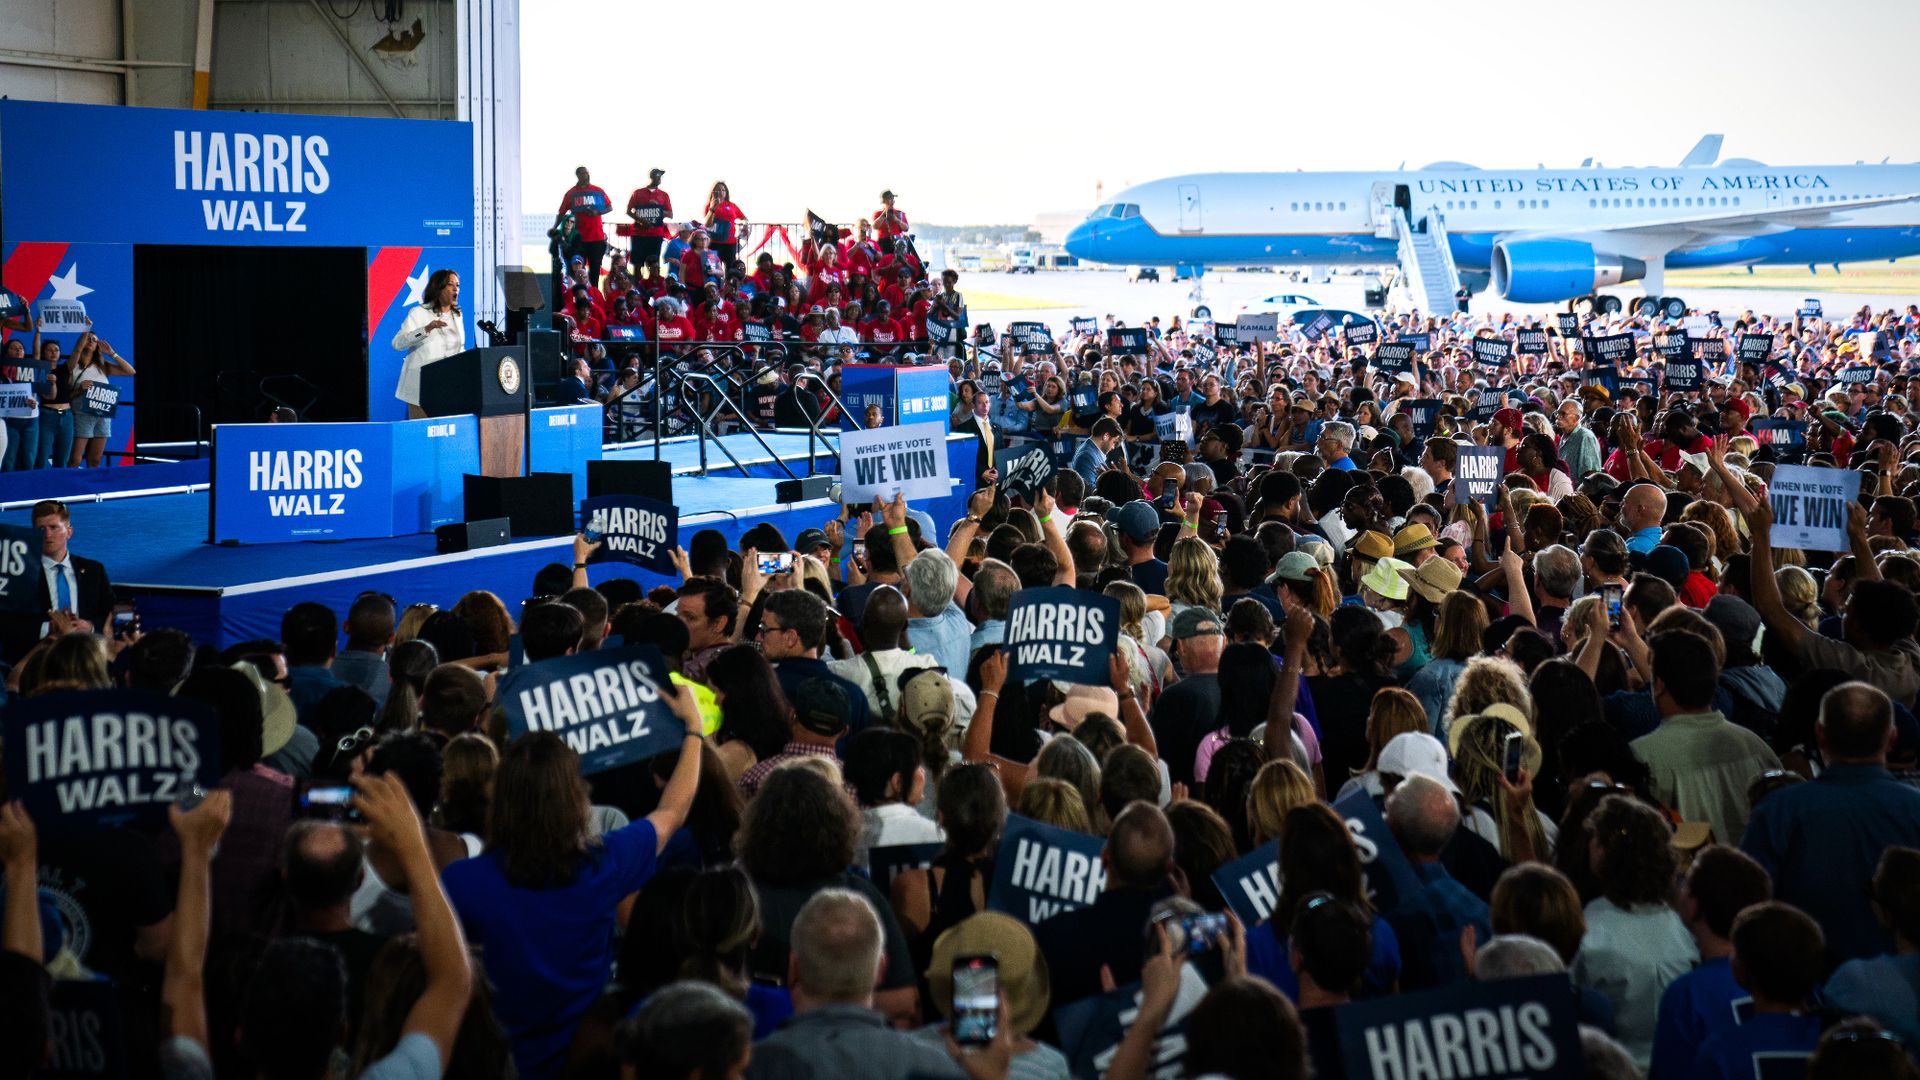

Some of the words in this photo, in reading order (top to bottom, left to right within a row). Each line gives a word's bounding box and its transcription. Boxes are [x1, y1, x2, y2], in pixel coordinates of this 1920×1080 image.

[174, 130, 330, 194] HARRIS
[1418, 177, 1524, 194] UNITED
[1536, 176, 1638, 192] STATES
[1651, 175, 1684, 191] OF
[1701, 174, 1831, 190] AMERICA
[202, 199, 307, 232] WALZ
[43, 311, 60, 324] WE
[62, 311, 84, 324] WIN
[1240, 324, 1274, 332] KAMALA
[1347, 324, 1374, 338] HARRIS
[1353, 335, 1371, 343] WALZ
[1520, 332, 1548, 343] HARRIS
[1655, 333, 1685, 348] HARRIS
[1742, 338, 1769, 352] HARRIS
[1378, 346, 1410, 360] HARRIS
[1475, 341, 1508, 357] HARRIS
[1597, 337, 1631, 354] HARRIS
[1660, 347, 1682, 355] WALZ
[1691, 341, 1723, 353] HARRIS
[1480, 354, 1502, 363] WALZ
[1603, 350, 1626, 360] WALZ
[1381, 359, 1402, 367] WALZ
[1666, 364, 1697, 378] HARRIS
[1838, 369, 1872, 382] HARRIS
[1669, 378, 1692, 387] WALZ
[86, 385, 118, 404] HARRIS
[847, 396, 859, 405] TEXT
[89, 400, 111, 412] WALZ
[911, 398, 923, 413] WIN
[855, 444, 885, 455] WHEN
[888, 441, 903, 451] WE
[905, 438, 931, 449] VOTE
[250, 448, 363, 491] HARRIS
[854, 455, 888, 486] WE
[890, 449, 937, 481] WIN
[1460, 455, 1498, 480] HARRIS
[1468, 481, 1494, 494] WALZ
[1774, 480, 1800, 492] WHEN
[1803, 483, 1817, 493] WE
[1819, 484, 1844, 495] VOTE
[268, 493, 345, 517] WALZ
[1770, 493, 1799, 526] WE
[1804, 496, 1842, 529] WIN
[592, 507, 667, 544] HARRIS
[607, 536, 656, 560] WALZ
[1008, 603, 1105, 645] HARRIS
[1018, 644, 1086, 668] WALZ
[519, 660, 659, 732] HARRIS
[25, 713, 201, 784] HARRIS
[57, 772, 178, 814] WALZ
[1364, 1002, 1557, 1080] HARRIS
